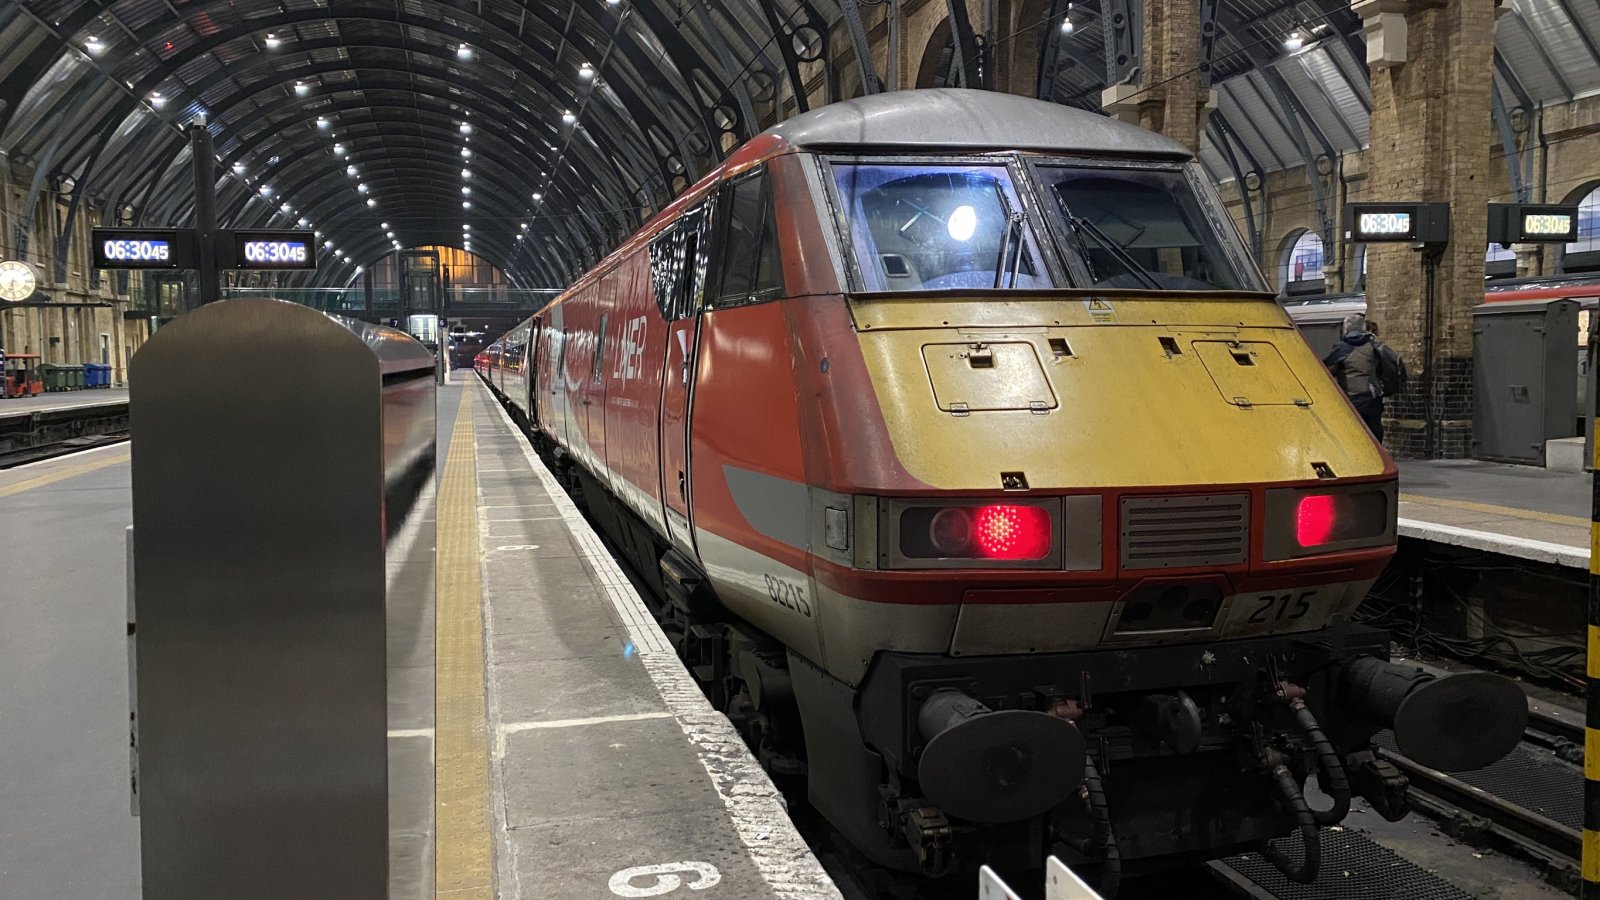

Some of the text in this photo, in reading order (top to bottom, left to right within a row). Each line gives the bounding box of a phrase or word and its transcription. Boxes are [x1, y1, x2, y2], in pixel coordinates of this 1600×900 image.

[613, 315, 648, 379] LNER
[764, 573, 811, 618] 82215
[1248, 591, 1317, 624] 215
